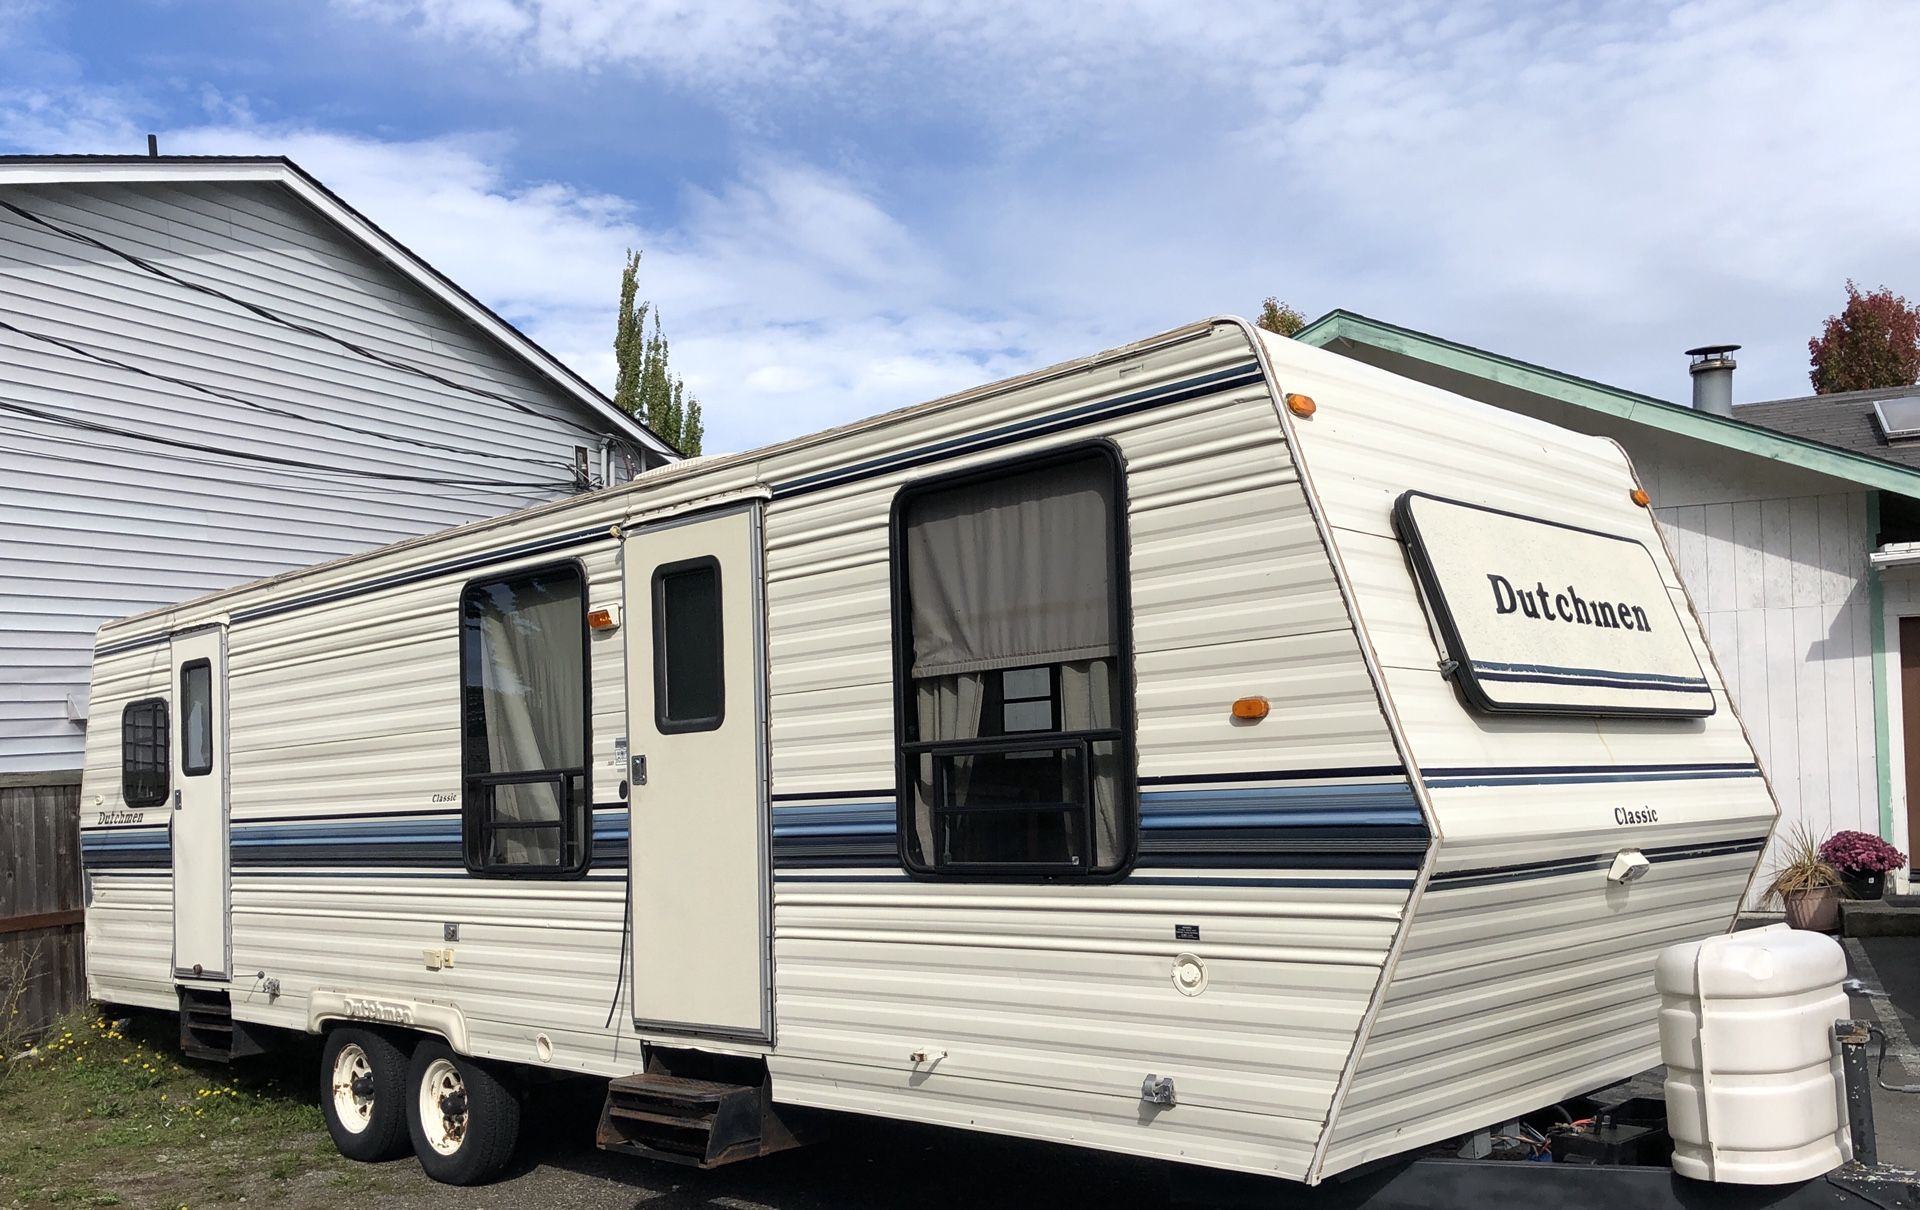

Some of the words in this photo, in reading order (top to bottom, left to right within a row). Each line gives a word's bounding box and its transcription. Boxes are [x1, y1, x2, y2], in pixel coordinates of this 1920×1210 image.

[1486, 573, 1652, 632] Dutchmen
[432, 793, 457, 803] Classic
[97, 810, 144, 825] Dutchmen
[1614, 805, 1659, 825] Classic
[343, 998, 415, 1024] Dutchmen
